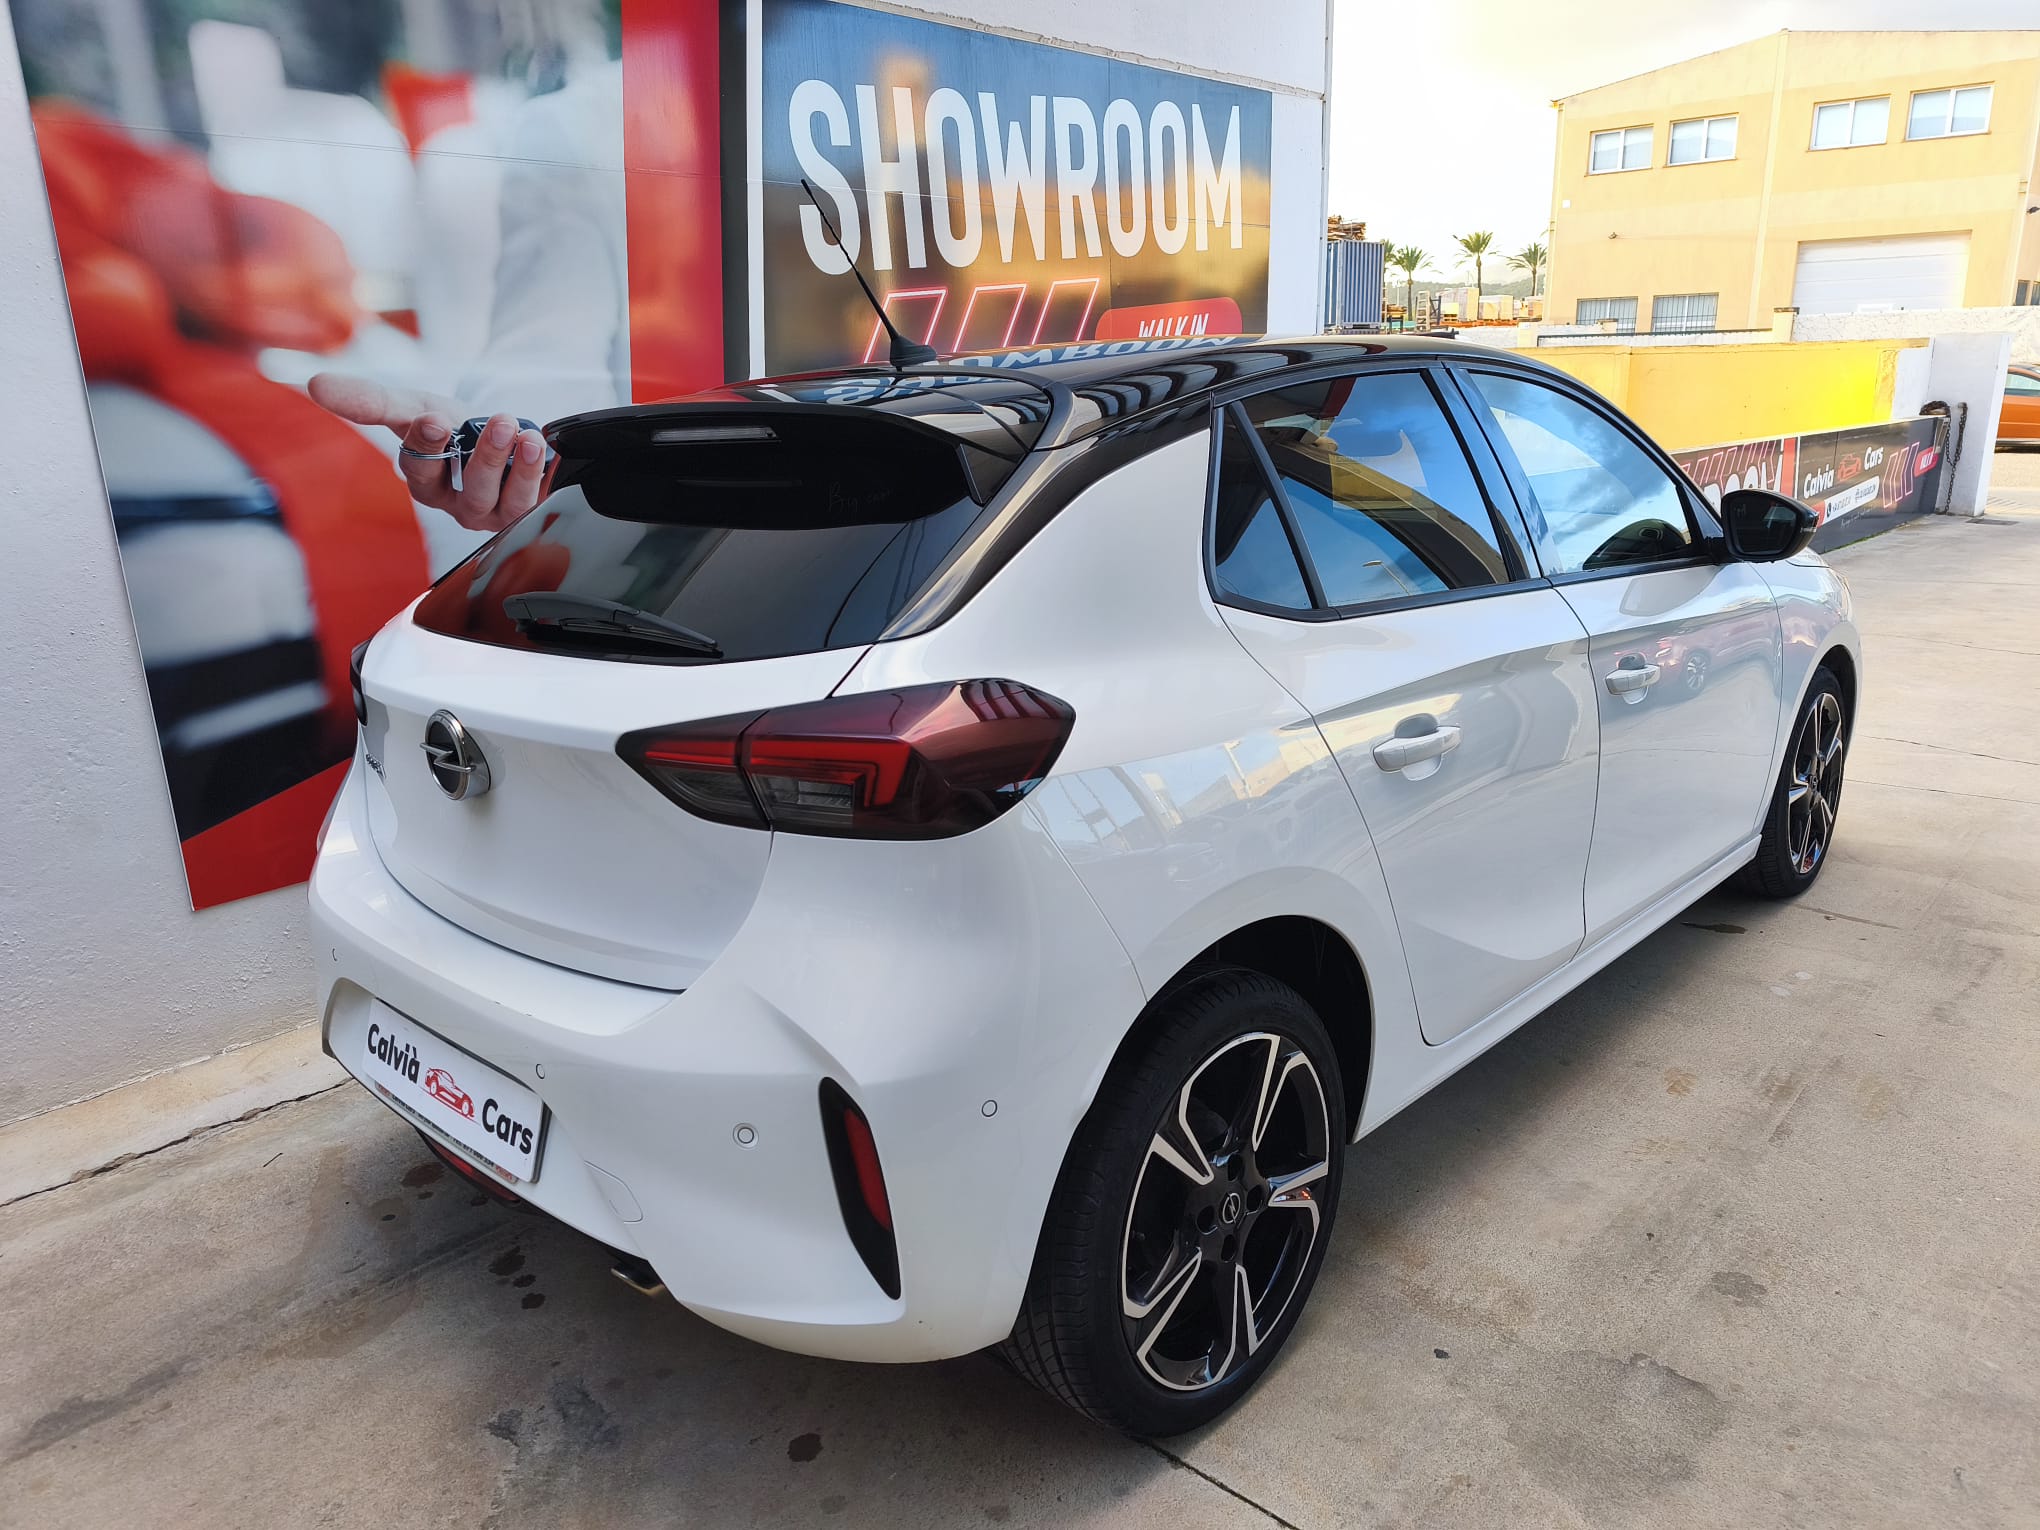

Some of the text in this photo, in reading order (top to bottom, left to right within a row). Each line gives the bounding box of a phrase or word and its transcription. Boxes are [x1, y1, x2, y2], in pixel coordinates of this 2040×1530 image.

[788, 79, 1243, 275] SHOWROOM
[1864, 446, 1884, 471] Cars
[367, 1023, 421, 1084] Calvià
[482, 1098, 534, 1155] Cars
